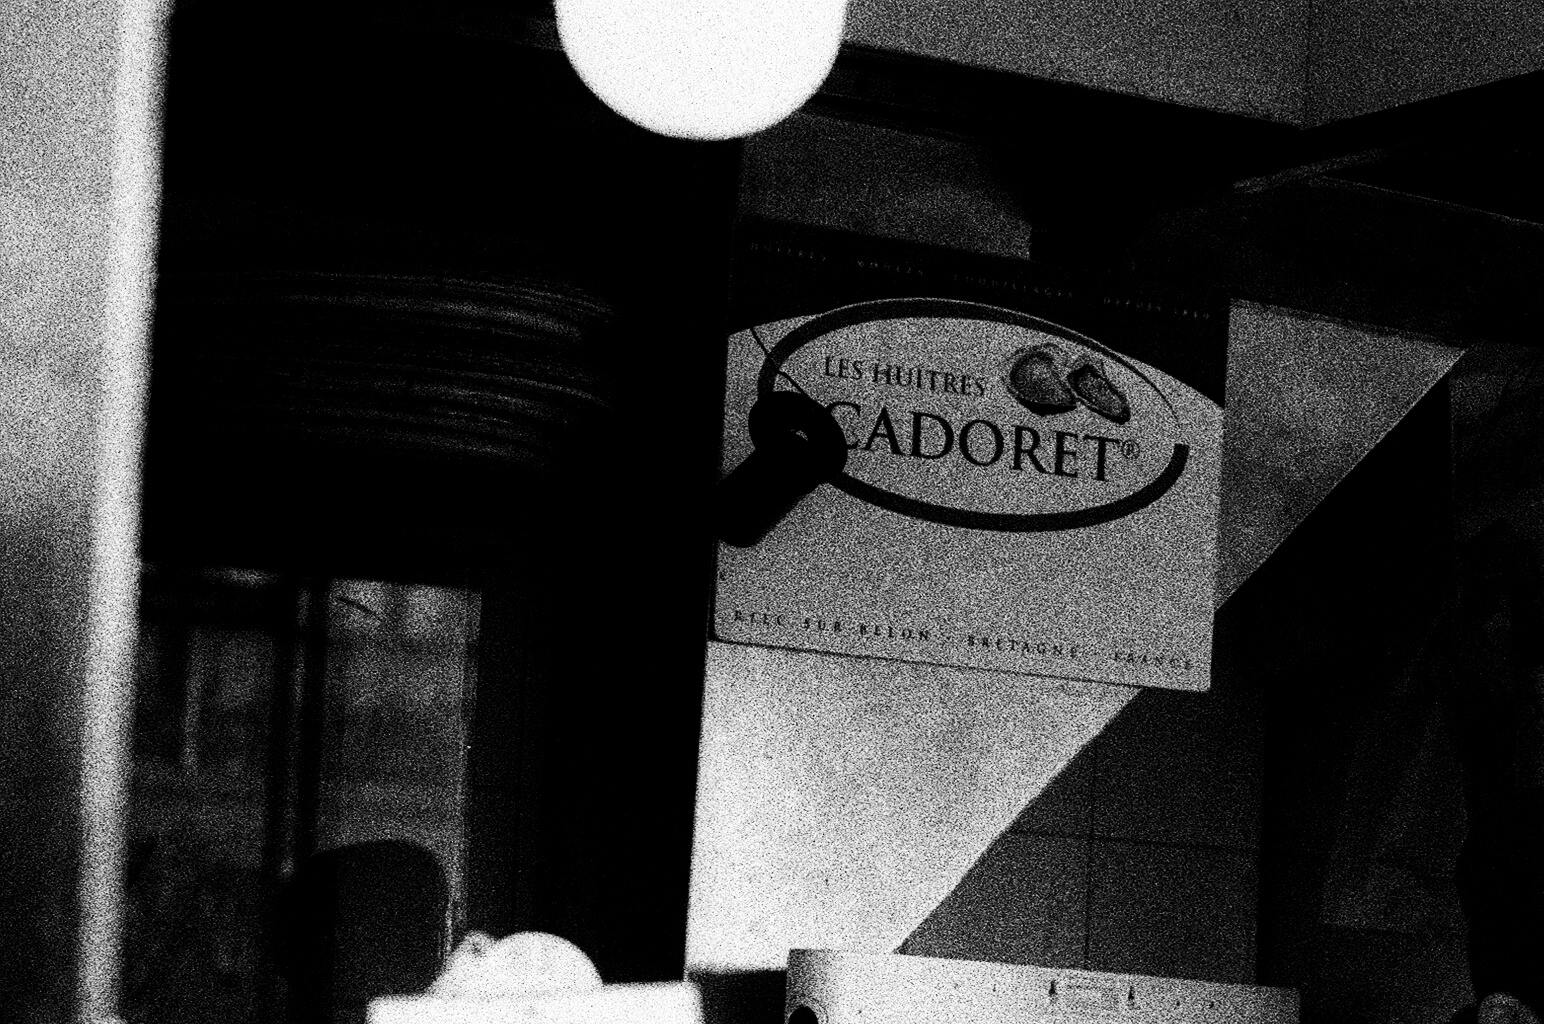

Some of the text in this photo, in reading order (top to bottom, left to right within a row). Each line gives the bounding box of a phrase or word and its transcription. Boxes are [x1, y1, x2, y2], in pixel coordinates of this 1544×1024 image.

[824, 354, 987, 398] LES HUITRES
[803, 617, 843, 633] SUR
[967, 634, 1079, 659] BRETAGNE
